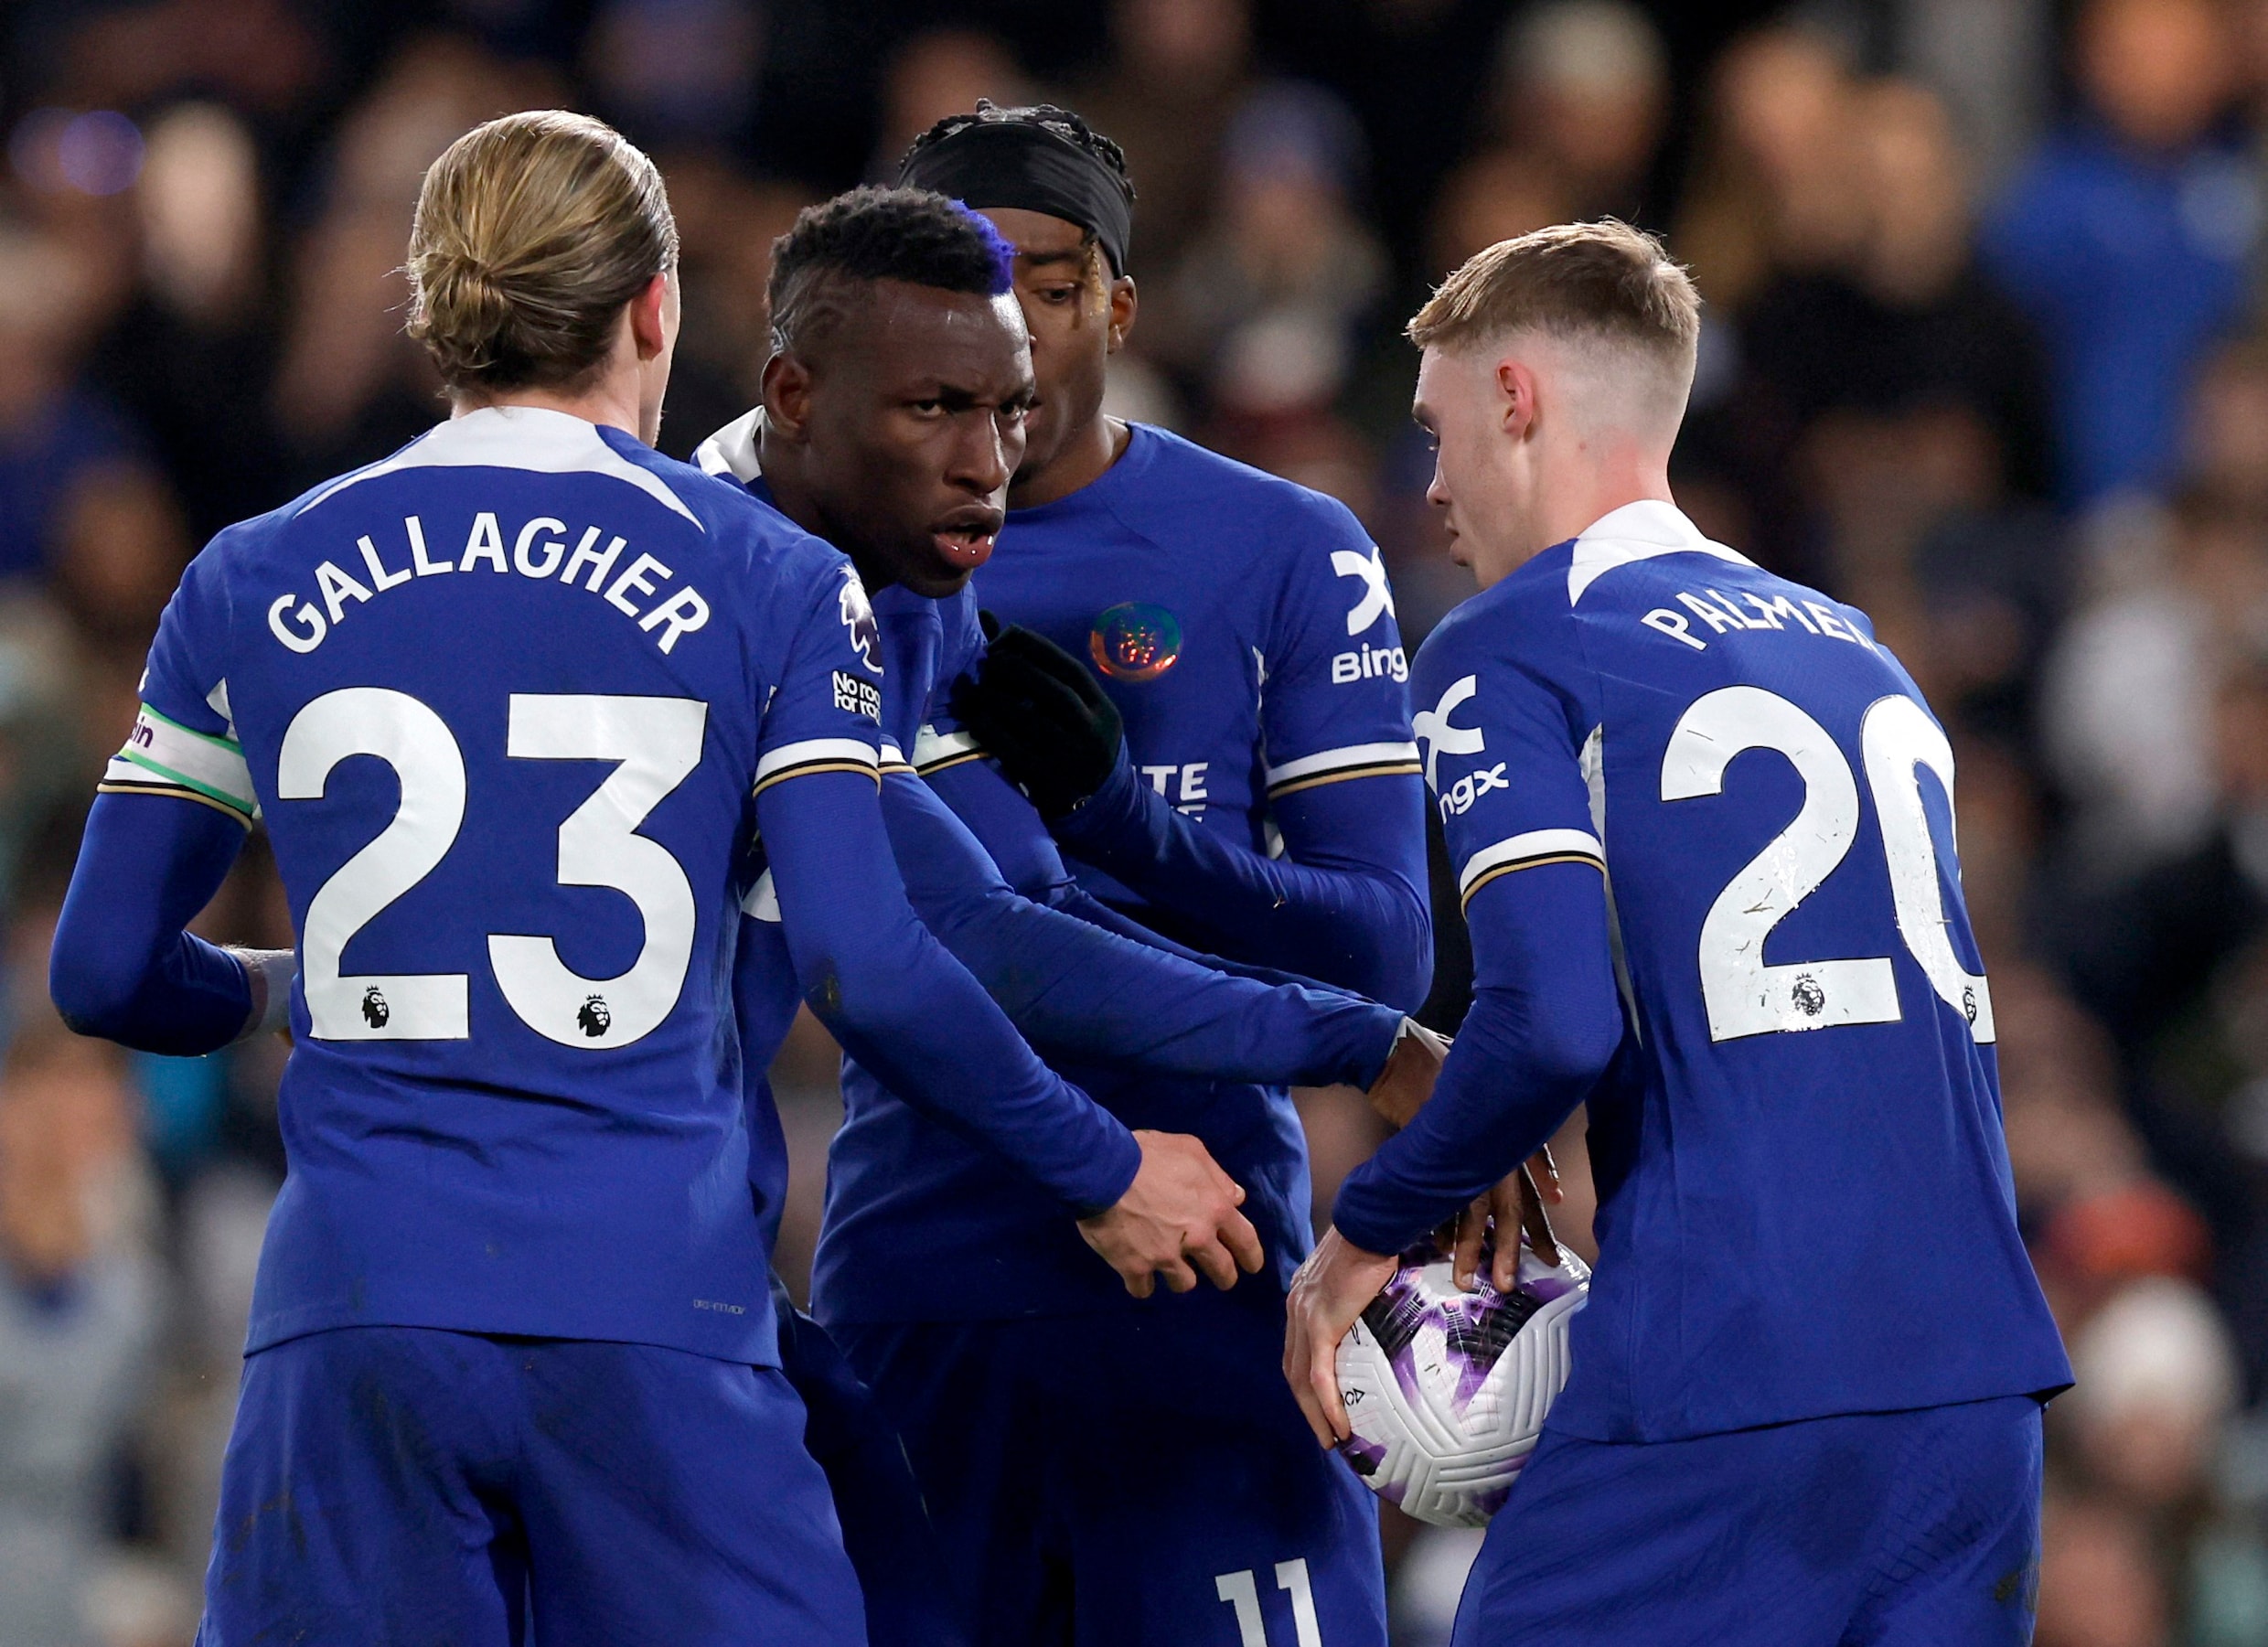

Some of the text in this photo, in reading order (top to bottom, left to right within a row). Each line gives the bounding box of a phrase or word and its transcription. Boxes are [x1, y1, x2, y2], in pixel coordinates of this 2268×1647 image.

[267, 512, 711, 655] GALLAGHER
[832, 670, 858, 695] No
[834, 689, 858, 713] for
[1332, 642, 1409, 684] Bing
[277, 686, 710, 1050] 23
[1660, 685, 1996, 1043] 20
[1214, 1557, 1322, 1647] 11
